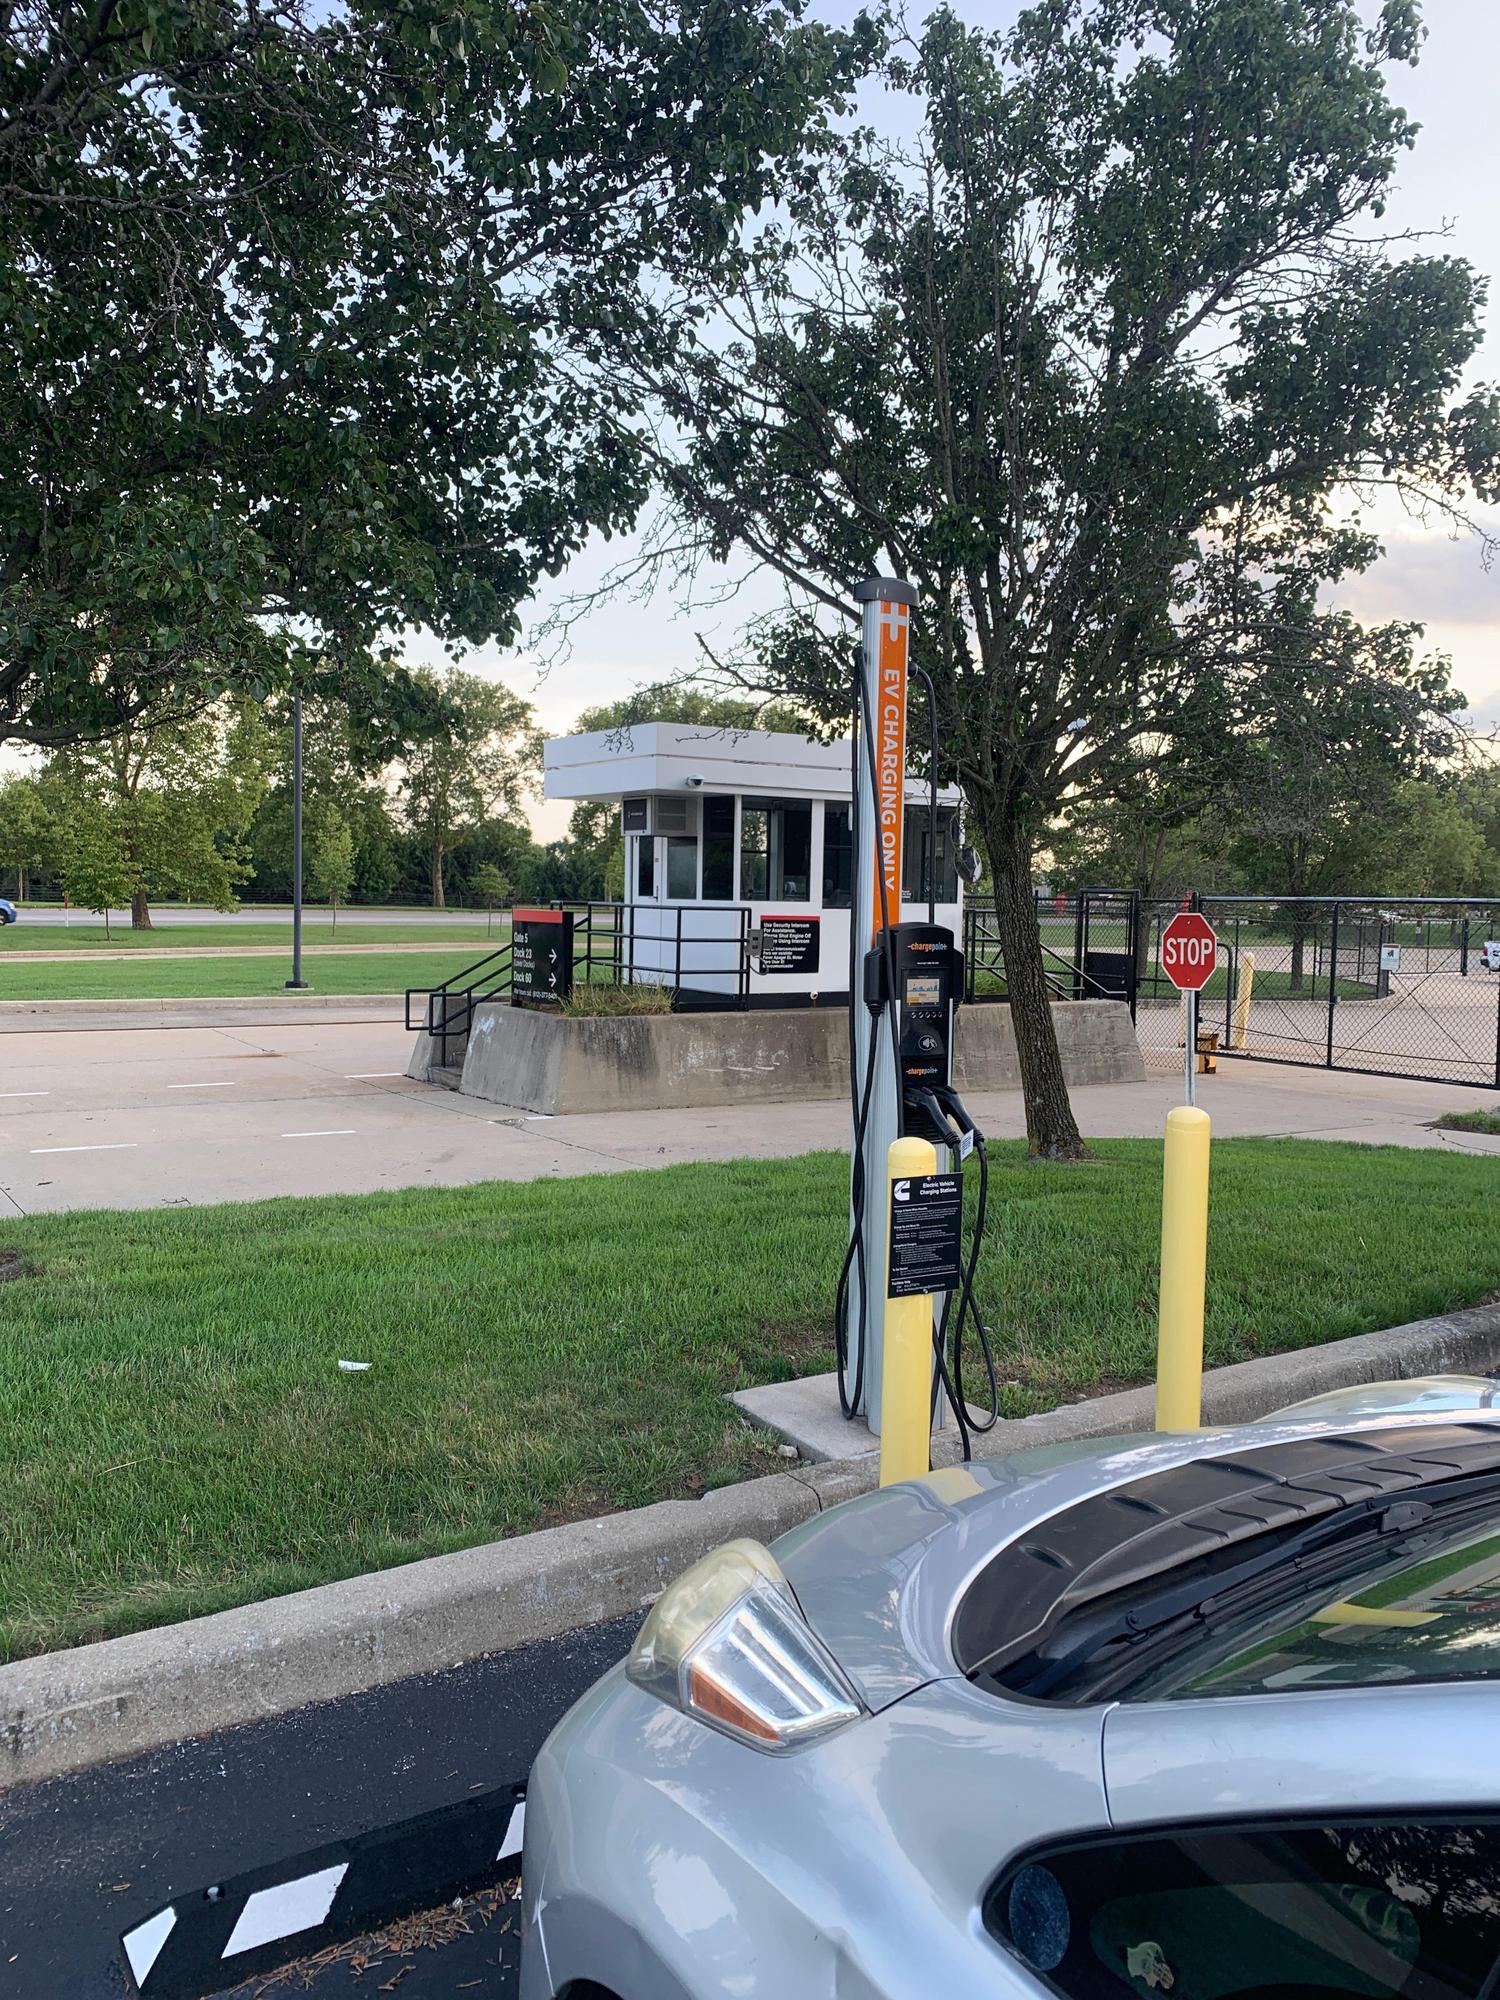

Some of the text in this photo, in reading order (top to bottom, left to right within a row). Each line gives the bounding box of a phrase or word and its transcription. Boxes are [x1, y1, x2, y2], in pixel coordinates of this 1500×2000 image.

[883, 668, 900, 699] EV
[880, 704, 899, 825] CHARGING
[514, 932, 529, 943] Gate 5
[514, 947, 532, 959] Dock 23
[1165, 937, 1213, 966] STOP
[514, 971, 532, 984] Dock 60
